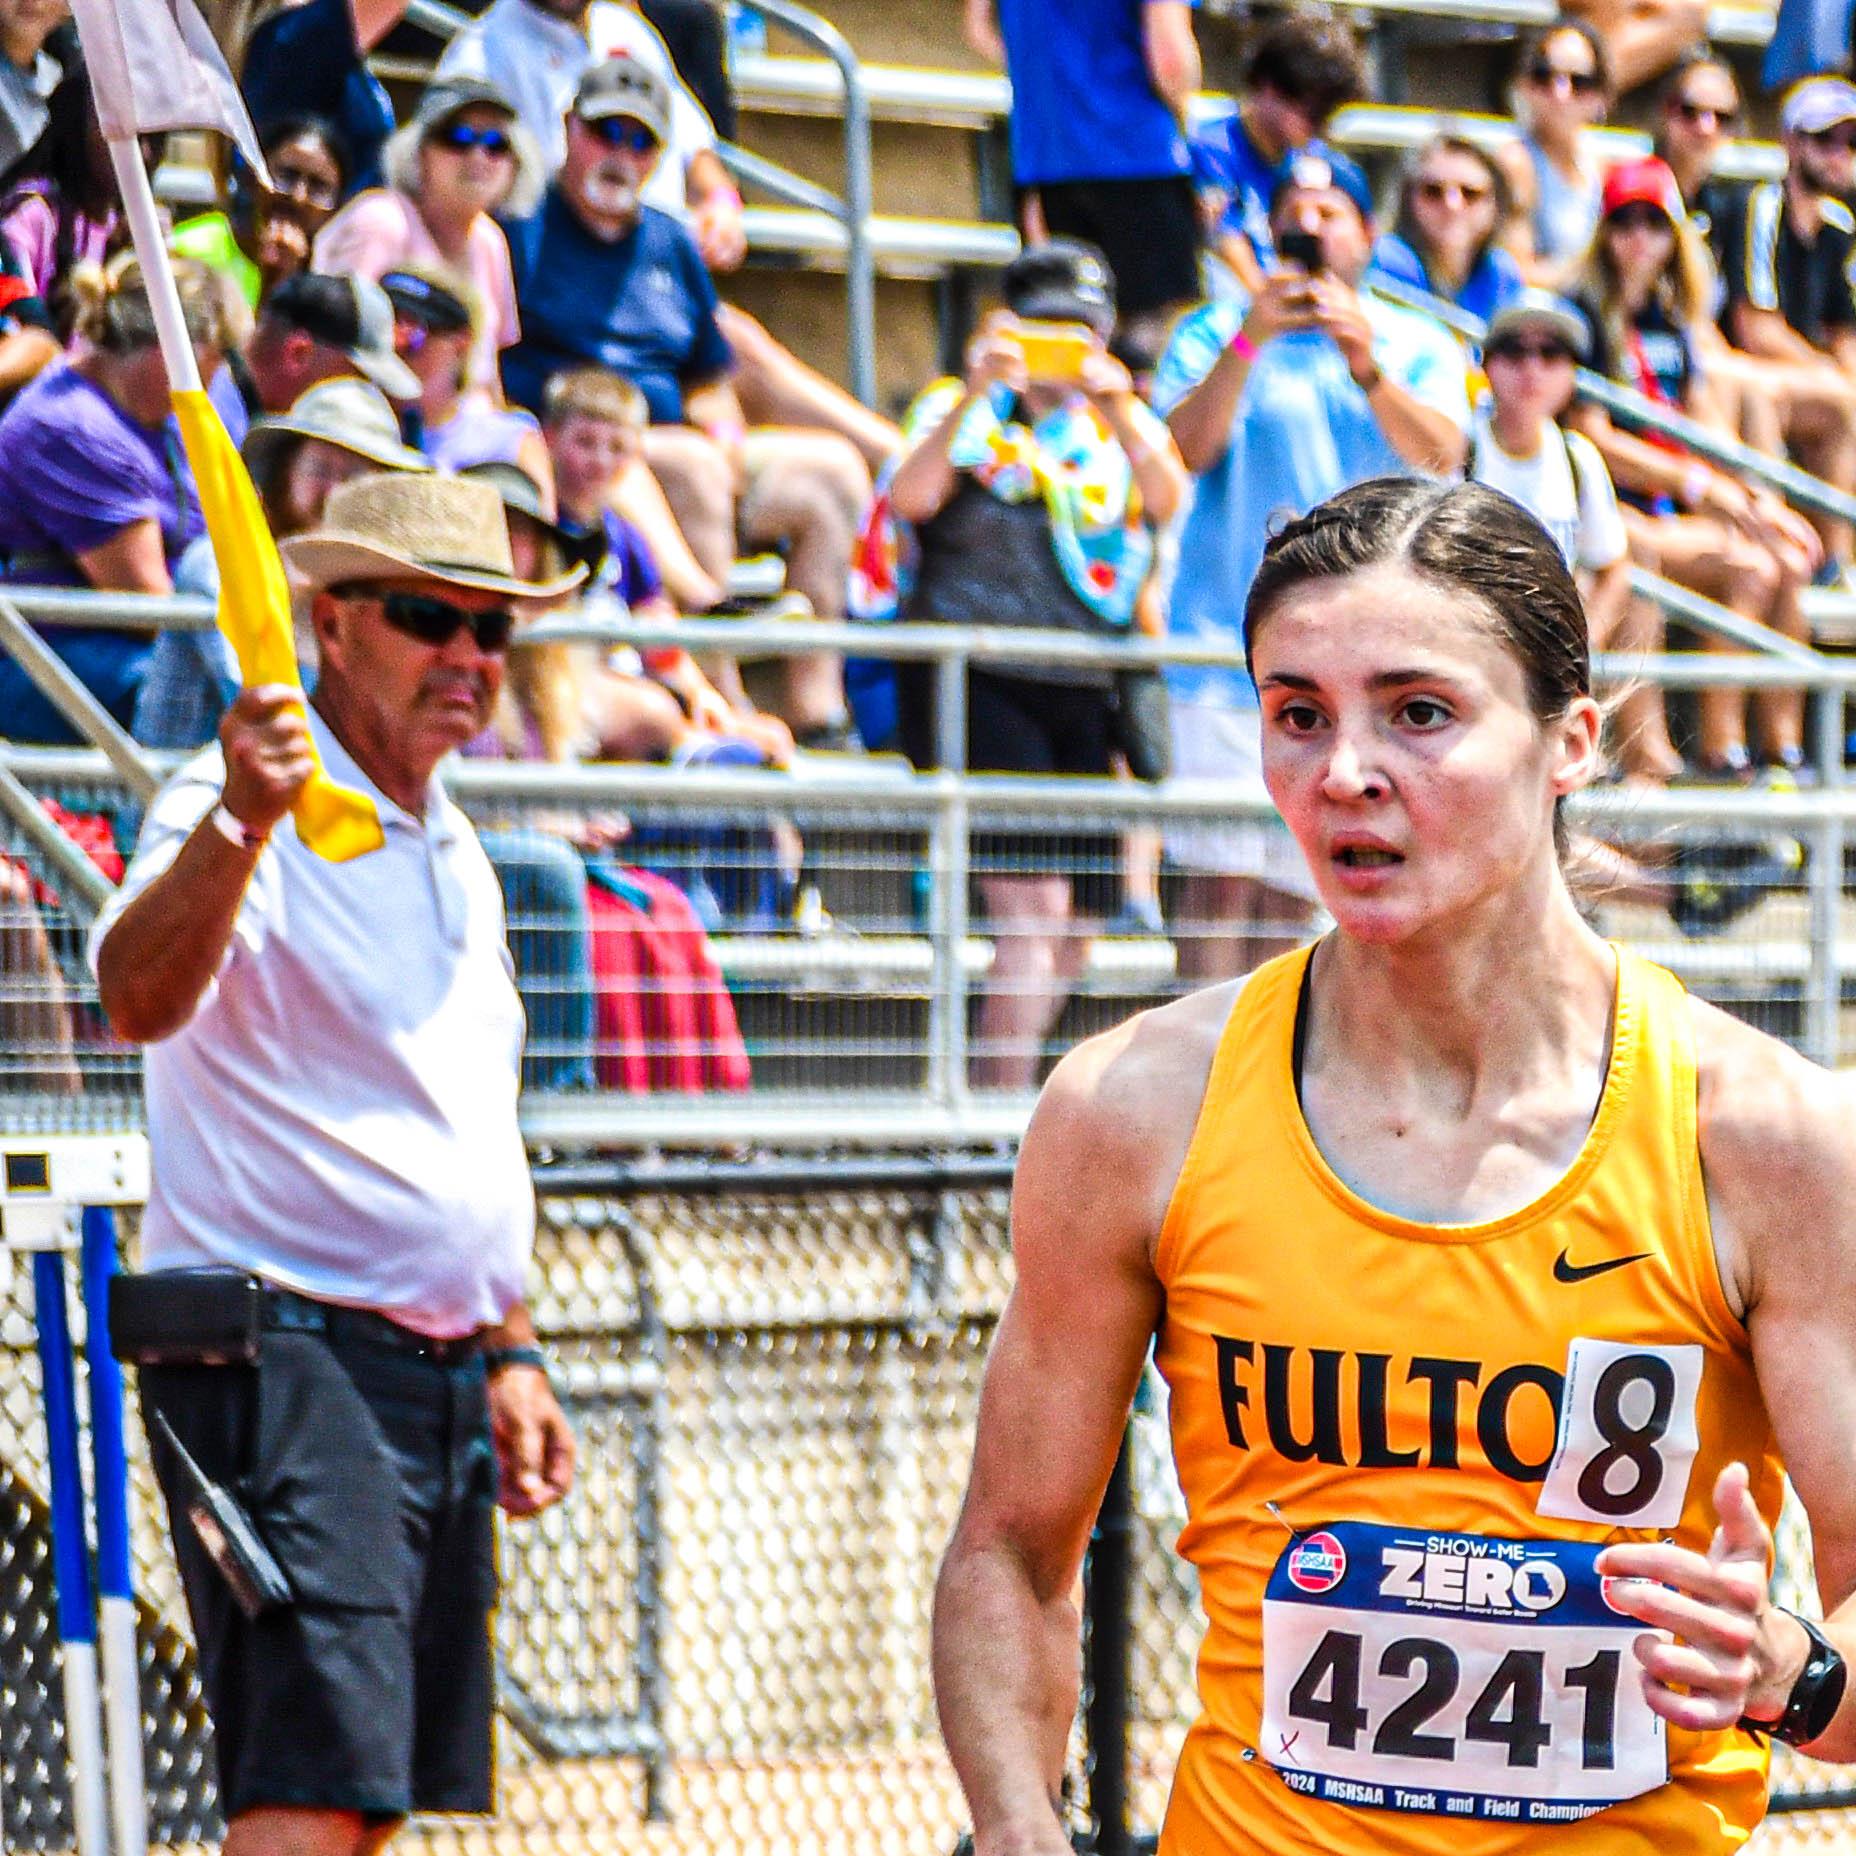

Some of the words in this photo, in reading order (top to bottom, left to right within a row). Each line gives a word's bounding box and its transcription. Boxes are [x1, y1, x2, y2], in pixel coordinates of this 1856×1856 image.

[1210, 1333, 1565, 1482] FULTO
[1577, 1354, 1676, 1516] 8
[1379, 1547, 1566, 1611] ZERO
[1426, 1535, 1525, 1561] SHOW-ME
[1288, 1629, 1622, 1771] 4241
[1283, 1769, 1316, 1793] 2024
[1324, 1778, 1385, 1805] MSHSAA
[1395, 1789, 1437, 1811] Track
[1446, 1796, 1475, 1814] and
[1483, 1799, 1520, 1818] Field
